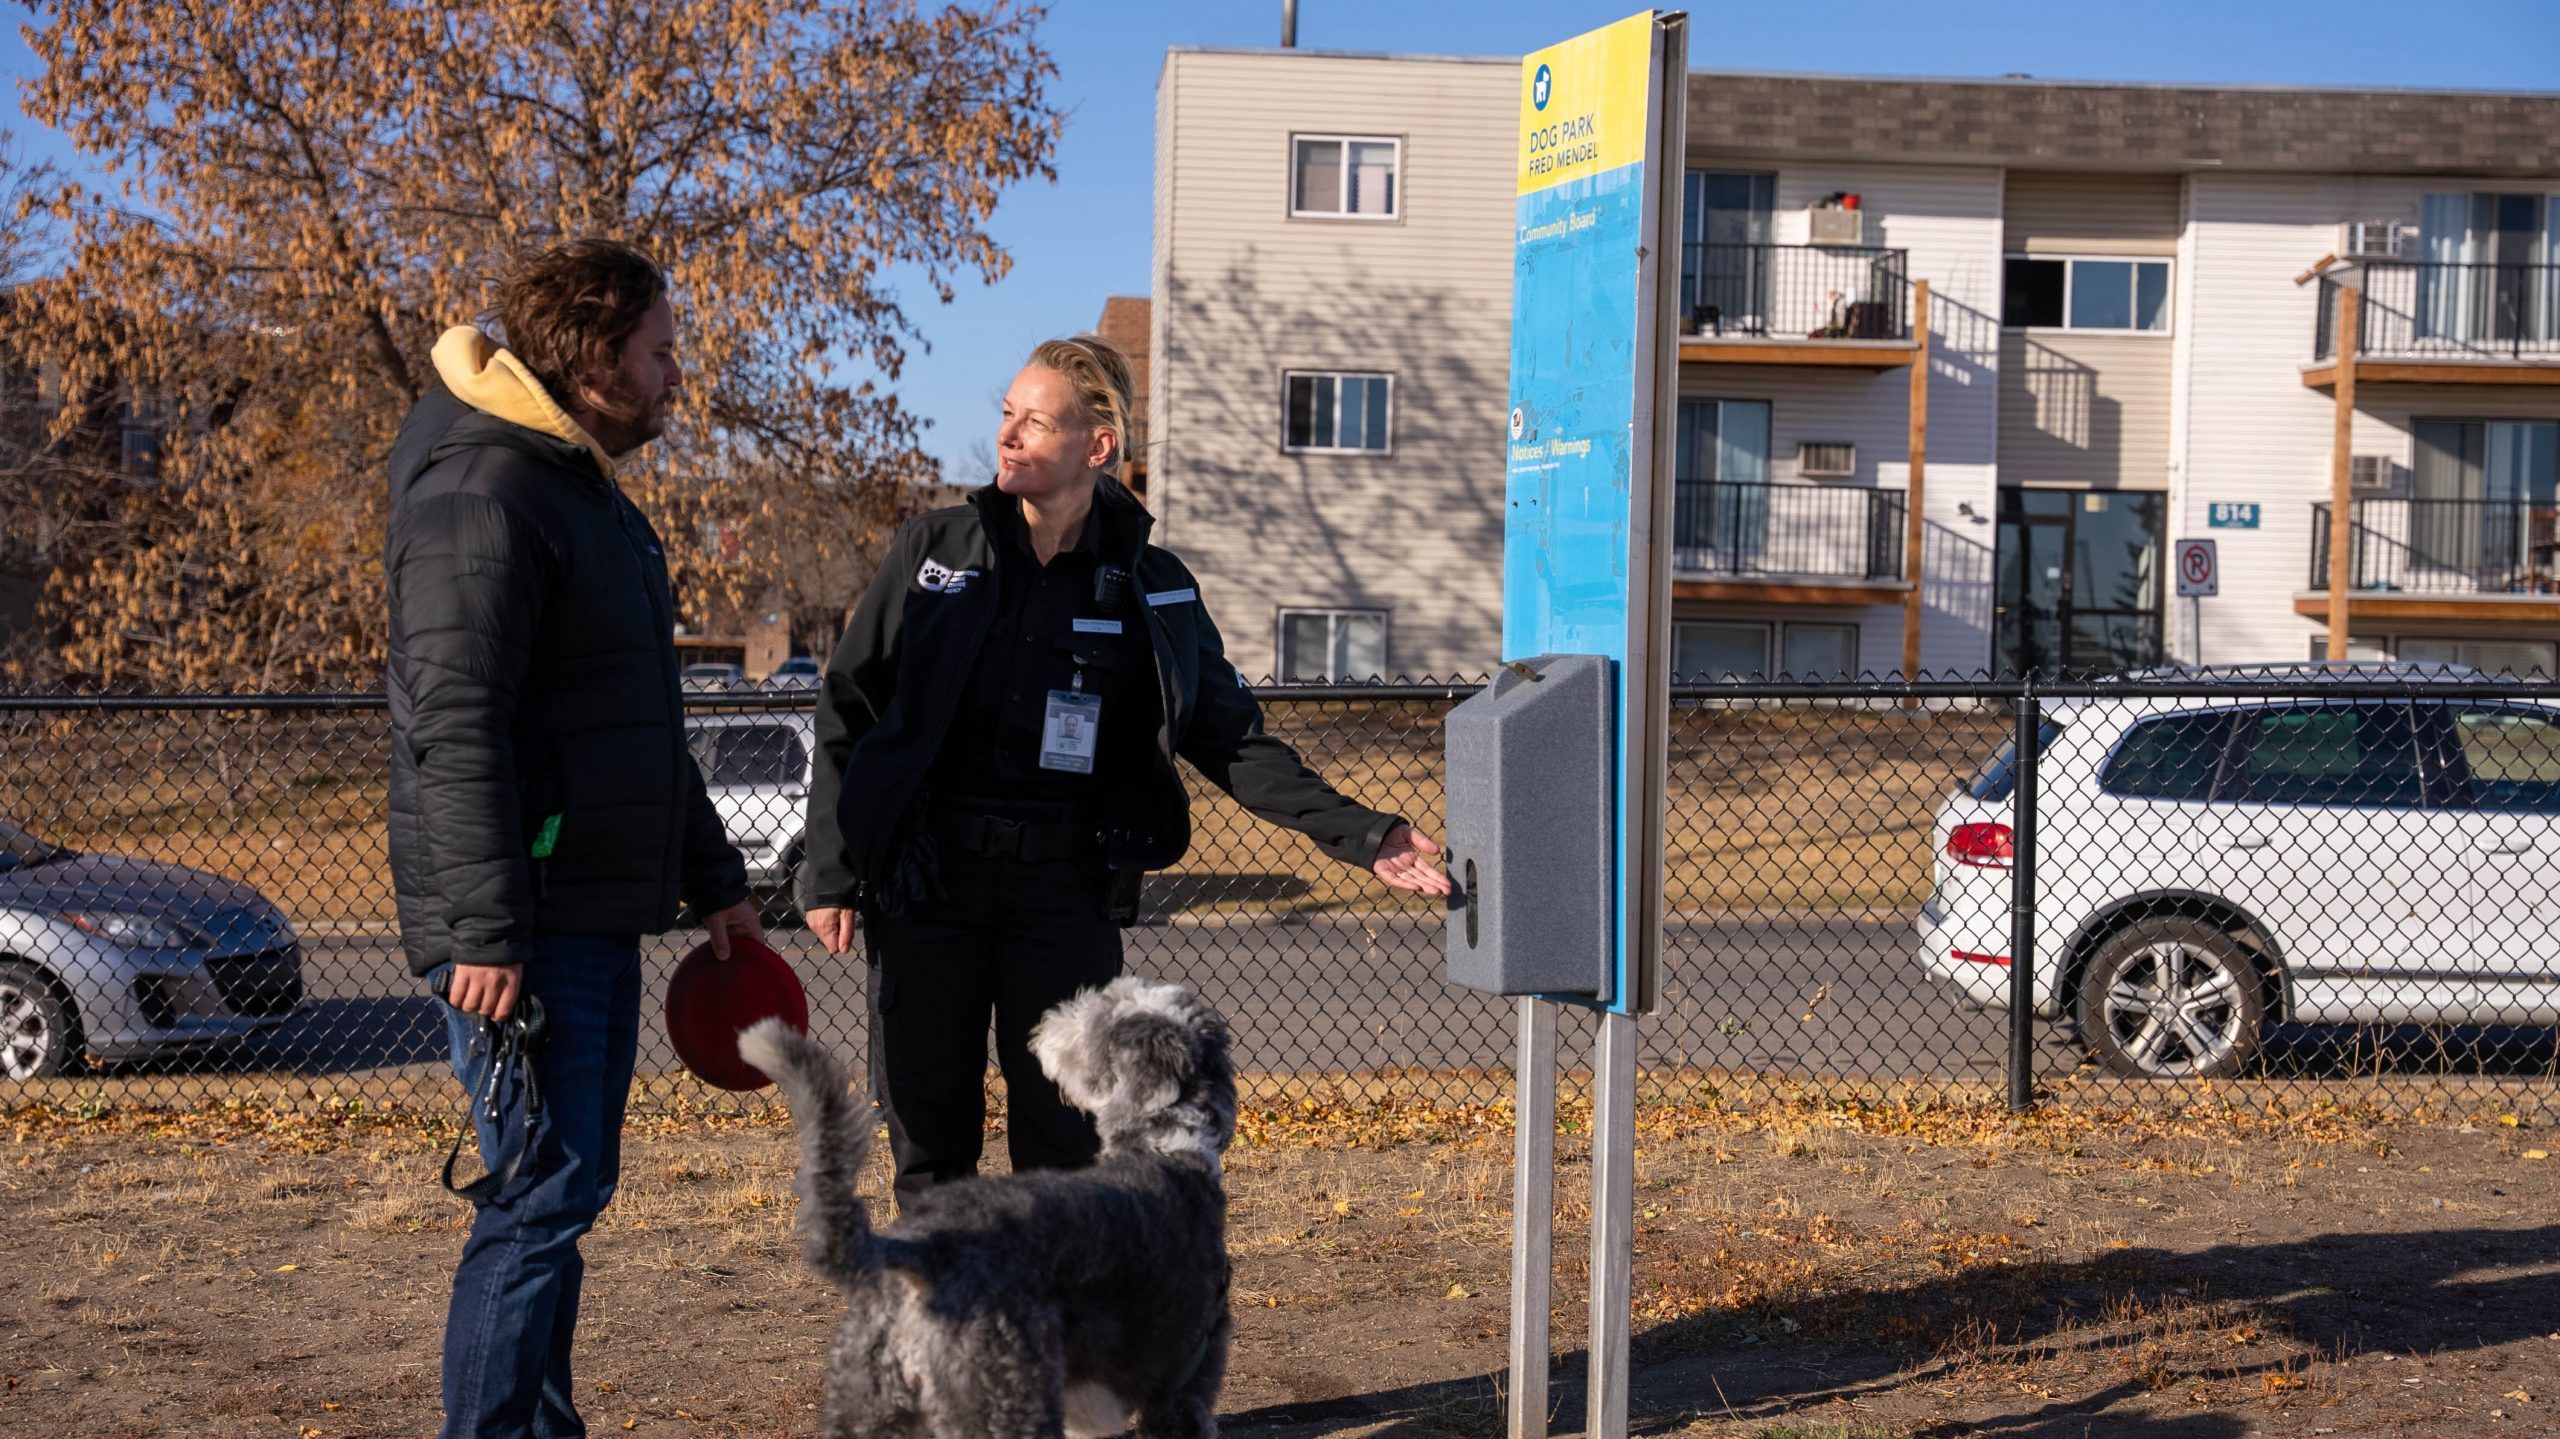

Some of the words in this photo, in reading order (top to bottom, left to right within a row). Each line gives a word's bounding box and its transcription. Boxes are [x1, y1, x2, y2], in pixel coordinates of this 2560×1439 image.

[1530, 125, 1557, 153] DOG
[1562, 112, 1594, 143] PARK
[1529, 155, 1553, 177] FRED
[1557, 141, 1598, 169] MENDEL
[1520, 217, 1568, 244] Community
[1569, 208, 1597, 232] Board
[1512, 444, 1543, 461] Notices
[1551, 438, 1591, 458] Warnings
[2215, 504, 2253, 521] 814
